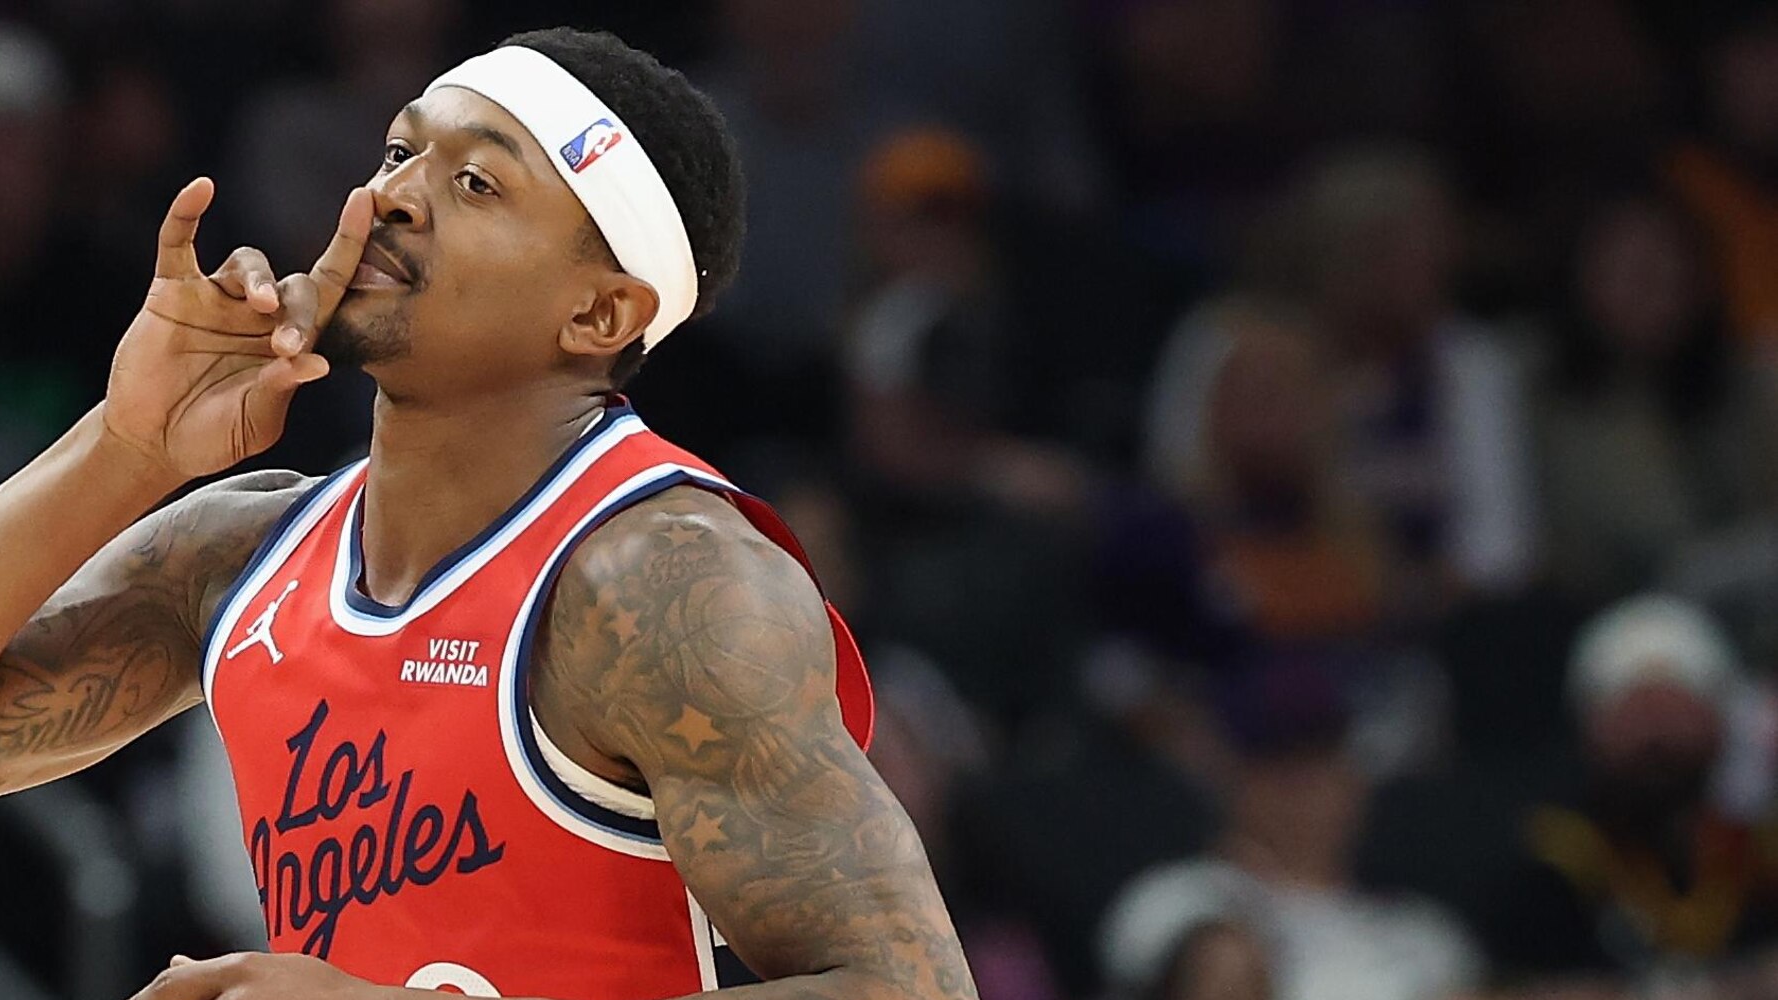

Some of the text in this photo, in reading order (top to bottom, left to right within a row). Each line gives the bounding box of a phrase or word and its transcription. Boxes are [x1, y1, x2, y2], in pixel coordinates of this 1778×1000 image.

[400, 660, 488, 687] RWANDA
[428, 638, 480, 662] VISIT
[275, 698, 392, 834] Los
[251, 769, 506, 960] Angeles
